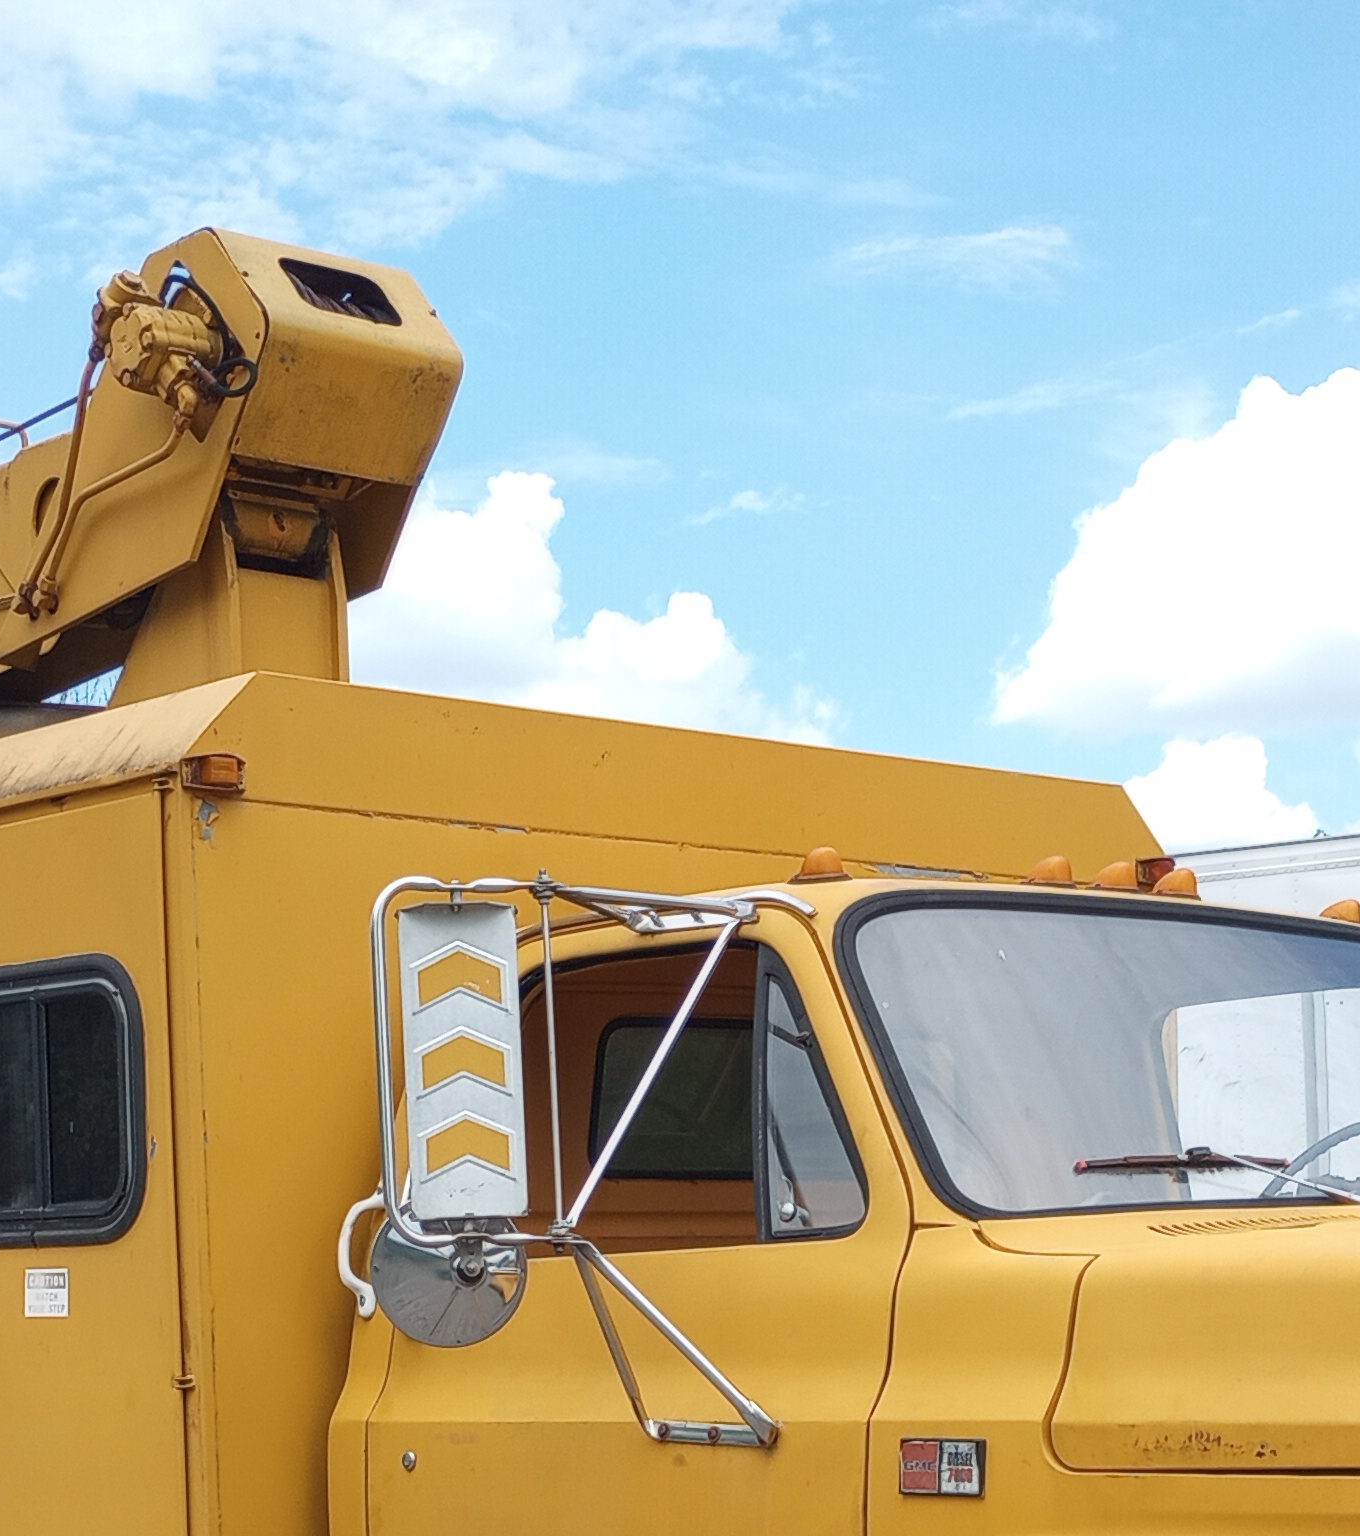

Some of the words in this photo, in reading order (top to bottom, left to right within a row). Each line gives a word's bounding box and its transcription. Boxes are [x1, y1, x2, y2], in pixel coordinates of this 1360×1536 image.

[29, 1275, 64, 1287] CAUTION
[35, 1292, 58, 1302] WATCH
[48, 1304, 65, 1313] STEP
[947, 1452, 973, 1467] DIESEL
[903, 1460, 937, 1471] GMC
